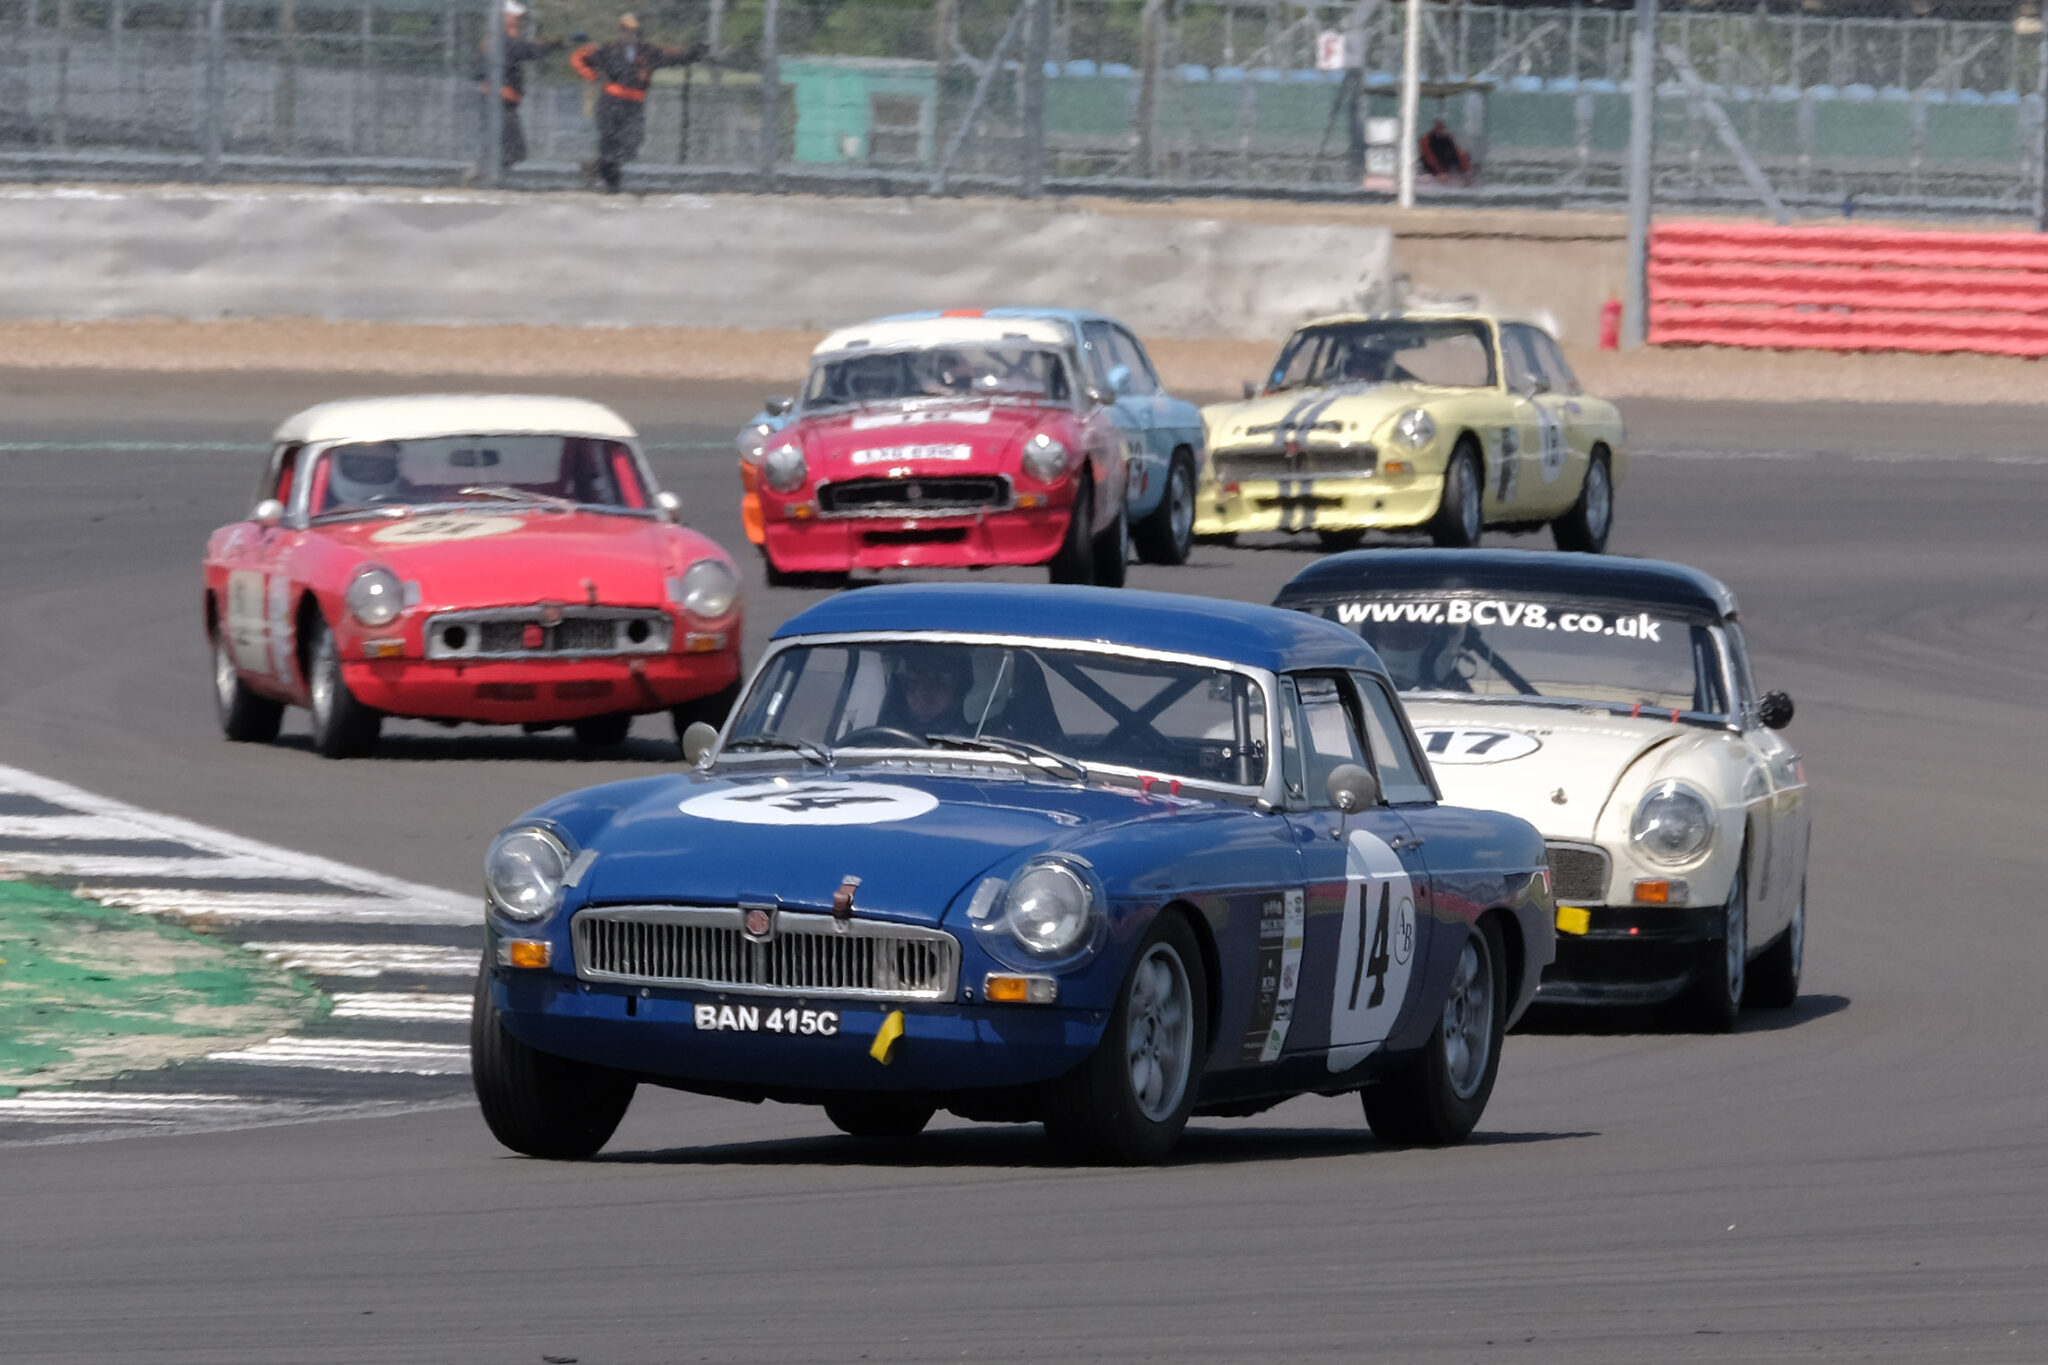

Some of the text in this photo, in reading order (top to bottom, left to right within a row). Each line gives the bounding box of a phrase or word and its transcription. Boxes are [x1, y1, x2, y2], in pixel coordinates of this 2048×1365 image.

[1337, 600, 1661, 642] www.BCV8.co.uk
[1423, 731, 1509, 755] 17
[723, 786, 896, 812] 14
[1348, 881, 1390, 1010] 14
[694, 1004, 838, 1036] BAN 415C
